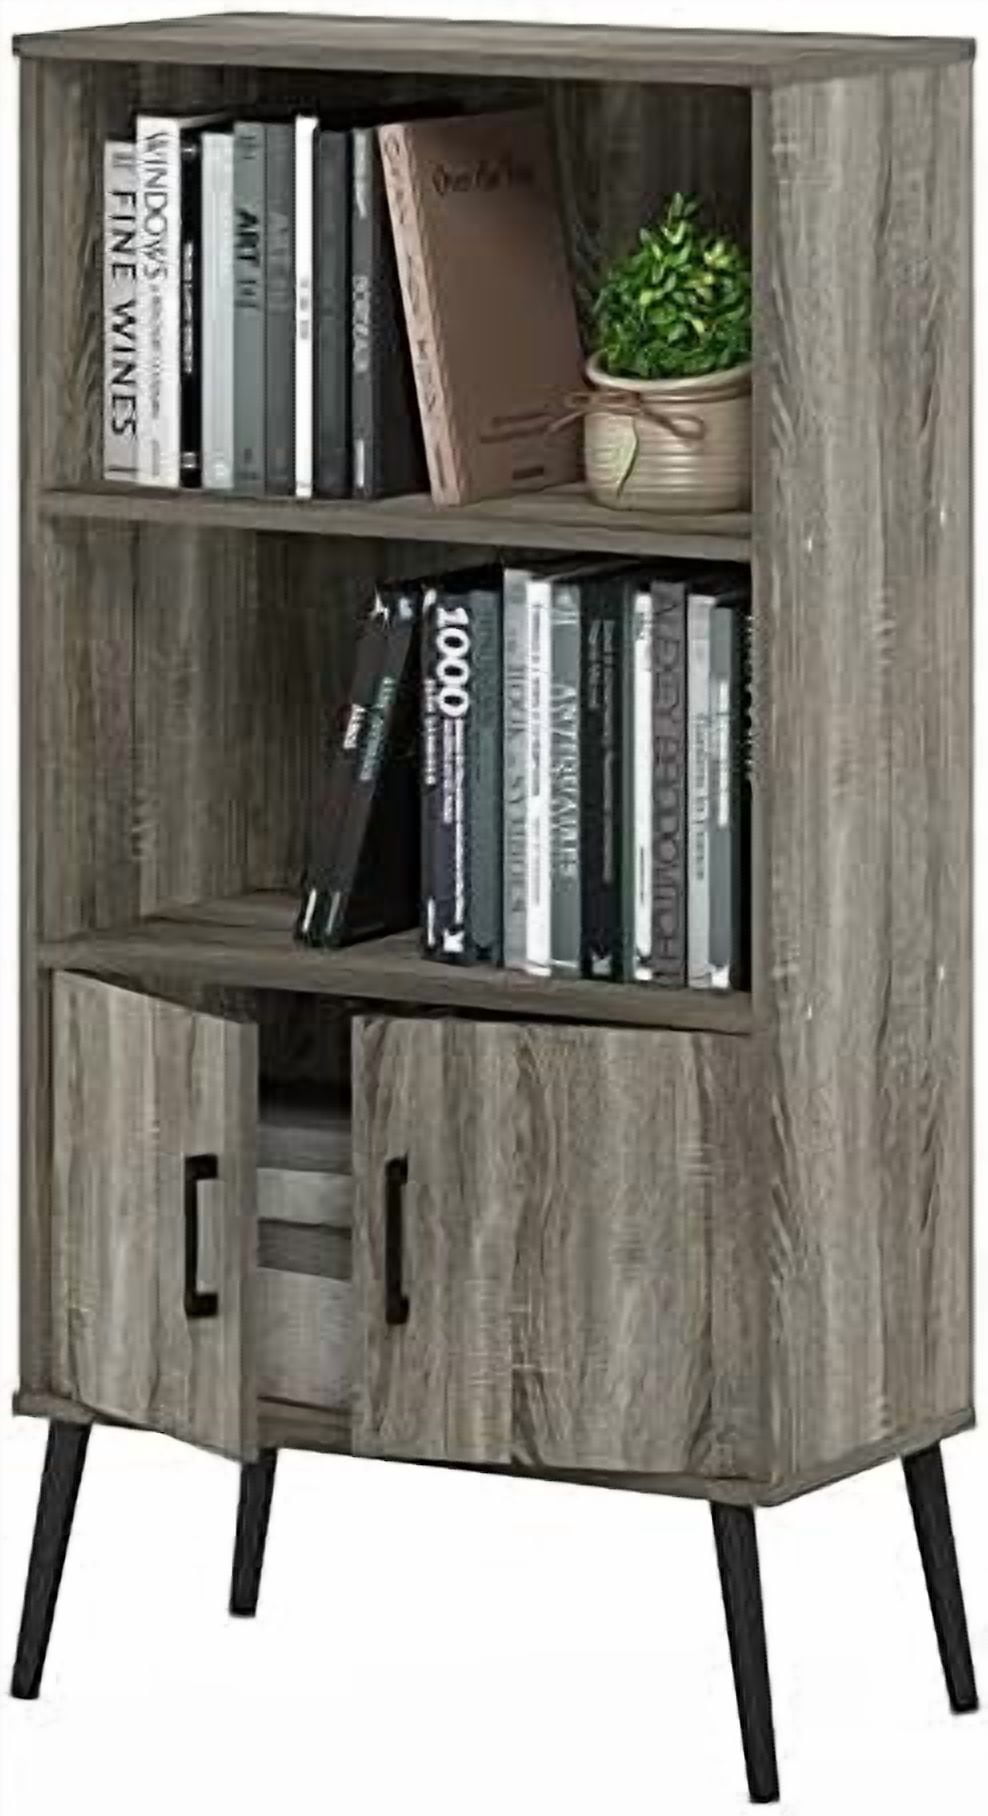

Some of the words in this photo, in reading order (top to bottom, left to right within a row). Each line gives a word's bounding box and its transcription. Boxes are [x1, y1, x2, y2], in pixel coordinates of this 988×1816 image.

[111, 190, 137, 288] FINE
[143, 131, 168, 281] WINDOWS
[111, 299, 137, 439] WINES
[436, 606, 470, 718] 1000
